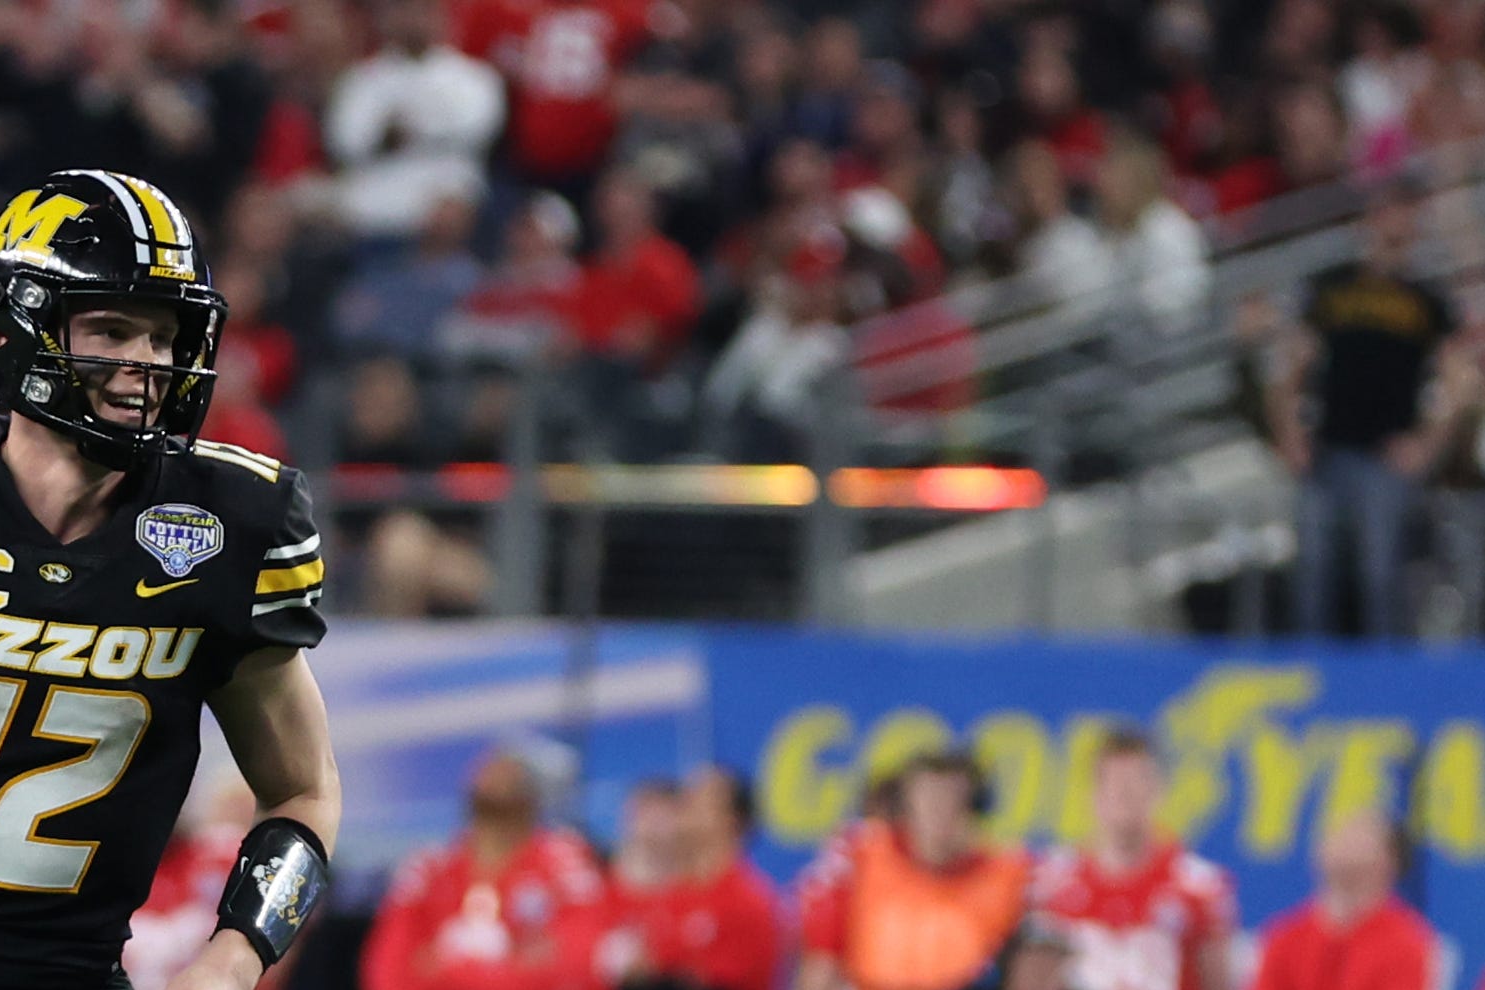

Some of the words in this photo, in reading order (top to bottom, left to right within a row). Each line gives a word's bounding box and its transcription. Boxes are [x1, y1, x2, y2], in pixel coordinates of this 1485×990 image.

[149, 266, 195, 281] MIZZOU
[144, 520, 216, 550] COTTON
[156, 535, 202, 553] BOWL
